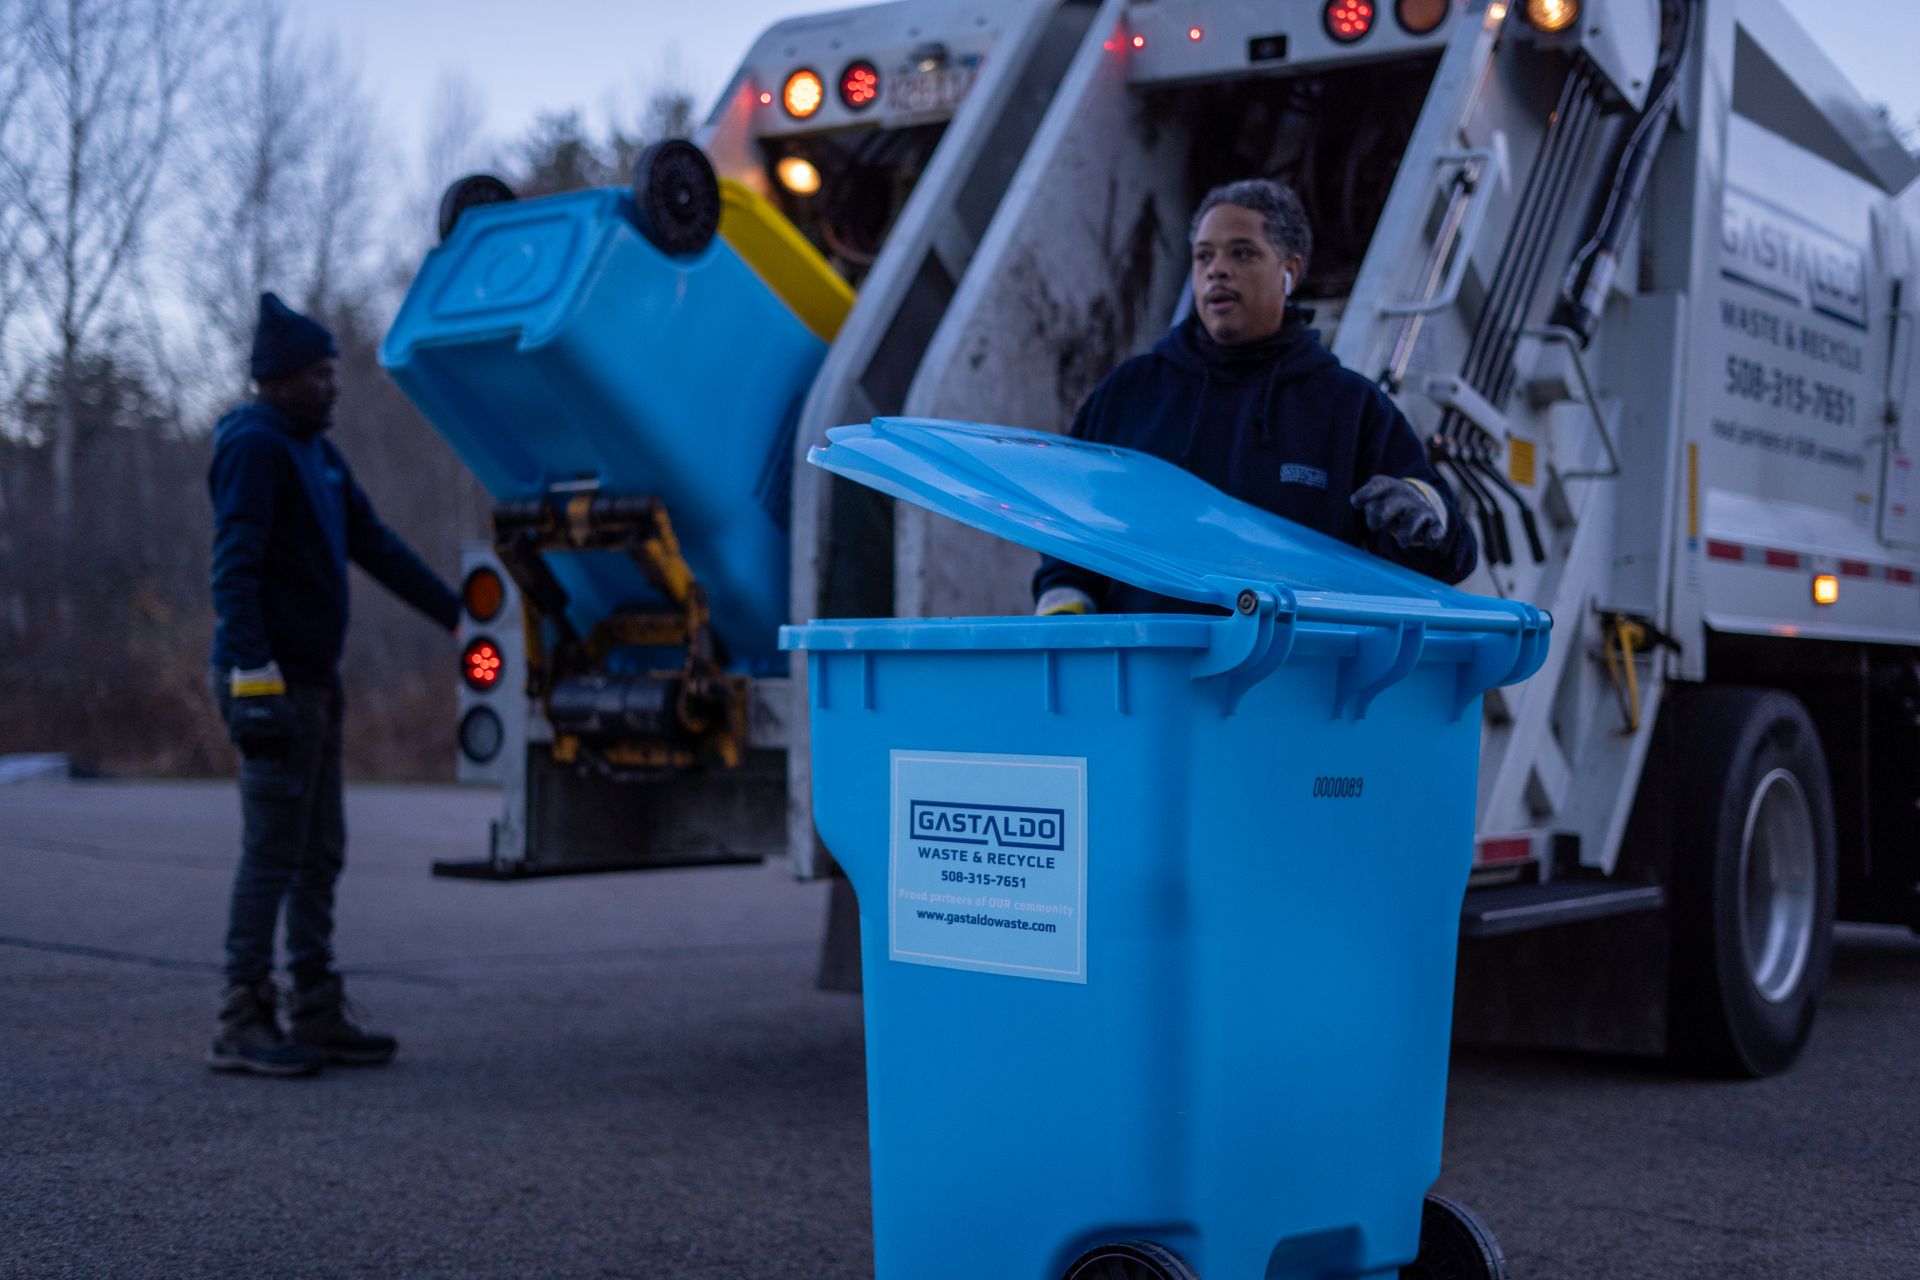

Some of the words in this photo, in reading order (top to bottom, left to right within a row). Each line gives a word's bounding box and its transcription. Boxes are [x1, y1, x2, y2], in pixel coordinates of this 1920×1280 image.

[1725, 354, 1855, 427] 508-315-7651
[1313, 776, 1364, 798] 0000089
[918, 810, 1056, 847] GASTALDO
[917, 846, 968, 862] WASTE
[972, 851, 982, 864] &
[987, 852, 1055, 869] RECYCLE
[941, 870, 1026, 889] 508-315-7651
[899, 888, 927, 901] Proud
[930, 893, 972, 906] partners
[975, 896, 986, 907] of
[988, 897, 1011, 910] OUR
[1014, 902, 1073, 918] community
[917, 909, 1056, 933] www.gastaldowaste.com
